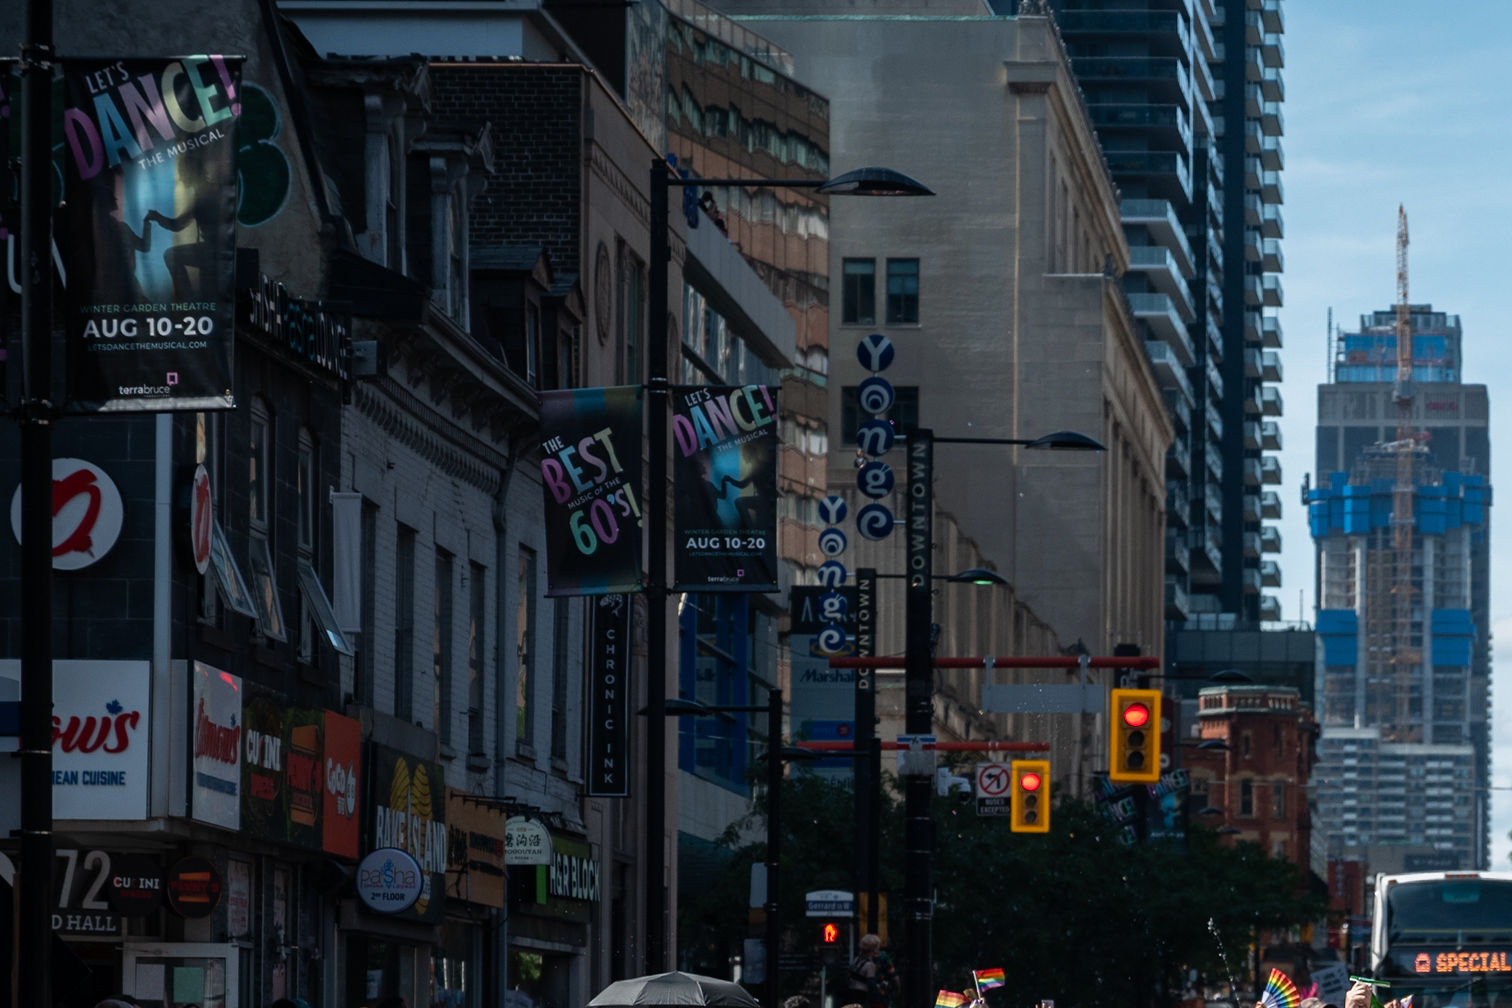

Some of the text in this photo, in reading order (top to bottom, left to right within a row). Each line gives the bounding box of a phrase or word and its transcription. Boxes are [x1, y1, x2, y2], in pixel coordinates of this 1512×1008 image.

[85, 60, 130, 94] LET'S
[64, 54, 242, 181] DANCE!
[137, 128, 226, 170] THE MUSICAL
[80, 302, 216, 315] WINTER GARDEN THEATRE
[82, 315, 214, 339] AUG 10-20
[118, 384, 172, 397] terrabruce
[684, 388, 711, 407] LET'S
[673, 384, 777, 458] DANCE!
[542, 435, 564, 455] THE
[716, 429, 768, 453] THE MUSICAL
[540, 426, 624, 504] BEST
[567, 492, 593, 510] MUSIC
[604, 479, 621, 490] THE
[911, 442, 926, 588] DOWNTOWN
[686, 537, 766, 550] AUG 10-20
[858, 579, 870, 691] DOWNTOWN
[800, 667, 855, 683] Marshal
[604, 629, 616, 784] CHRONIC INK
[82, 770, 127, 786] CUISINE
[571, 855, 601, 903] BLOCK
[382, 892, 406, 901] FLOOR
[808, 901, 837, 911] Gerrard
[67, 914, 117, 933] HALL
[1436, 951, 1512, 973] SPECIAL
